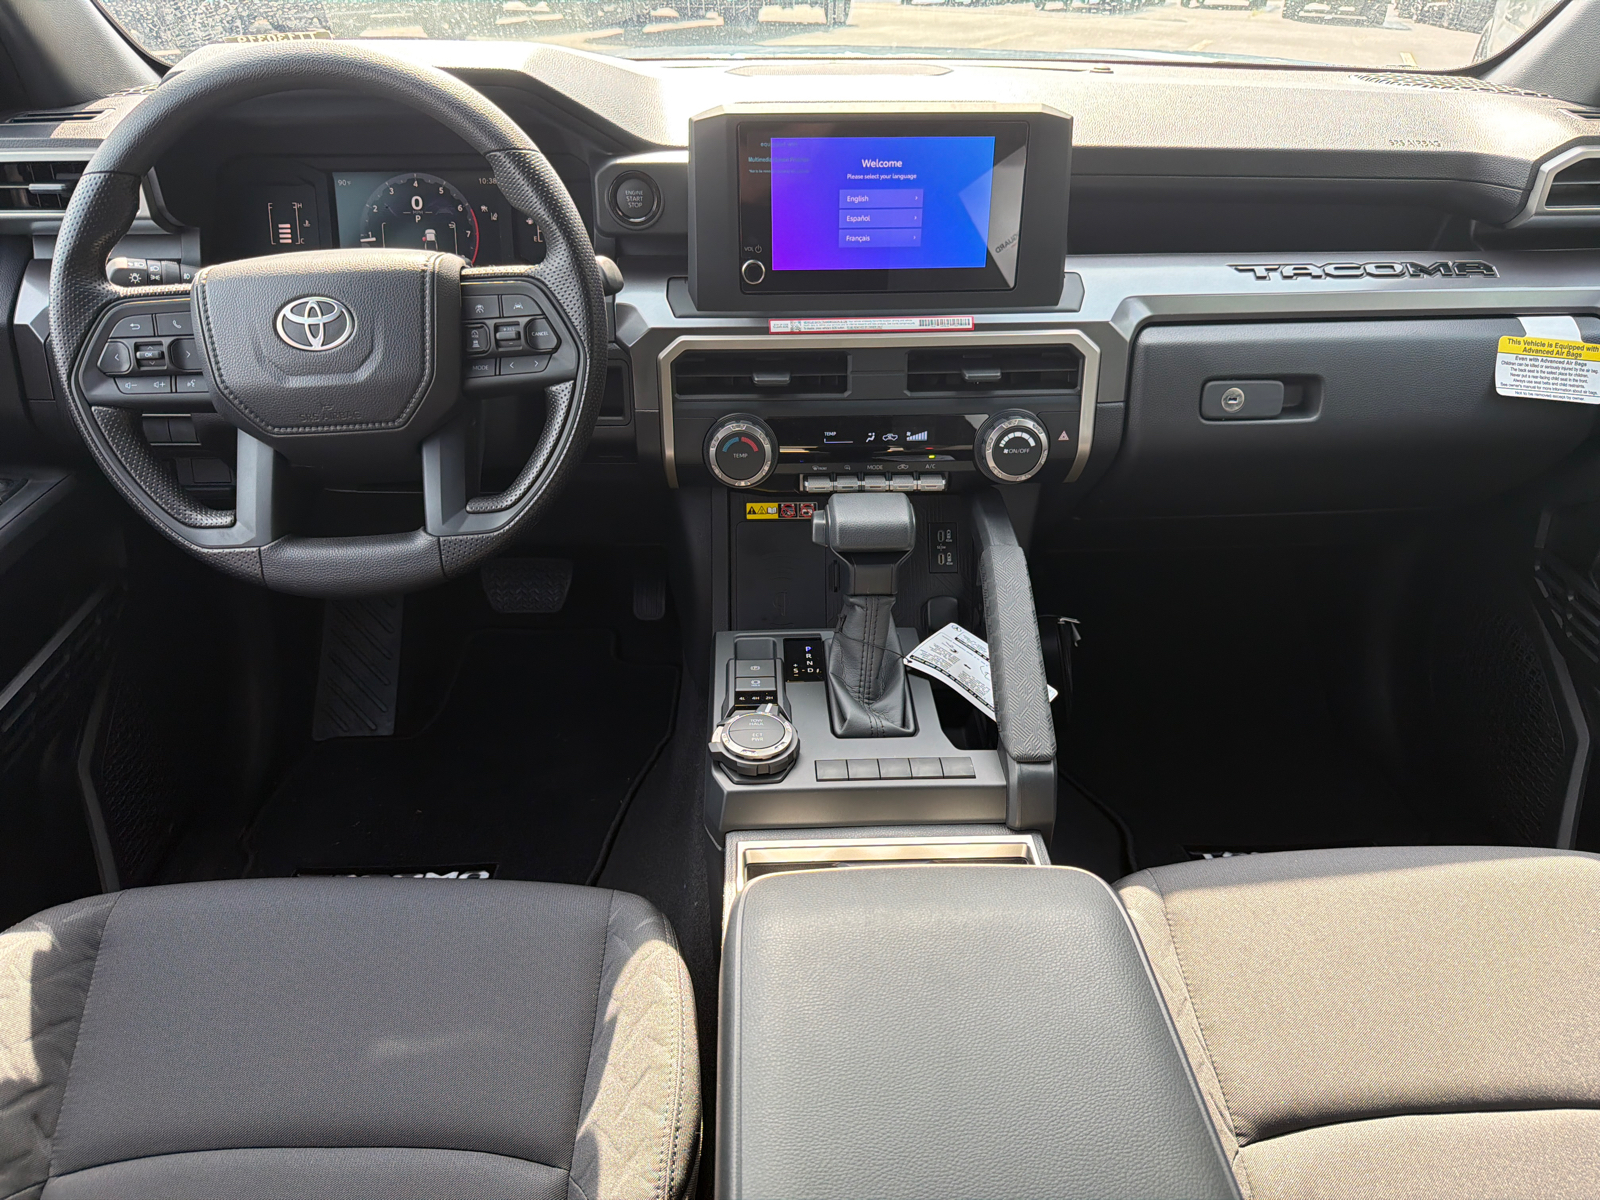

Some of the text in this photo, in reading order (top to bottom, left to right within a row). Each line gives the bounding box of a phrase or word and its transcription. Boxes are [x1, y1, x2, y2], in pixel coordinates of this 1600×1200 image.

[861, 159, 902, 168] Welcome
[411, 196, 423, 210] 0
[1226, 260, 1500, 281] TACOMA
[1523, 339, 1545, 347] Vehicle
[1555, 343, 1584, 351] Equipped
[1523, 347, 1554, 355] Advanced
